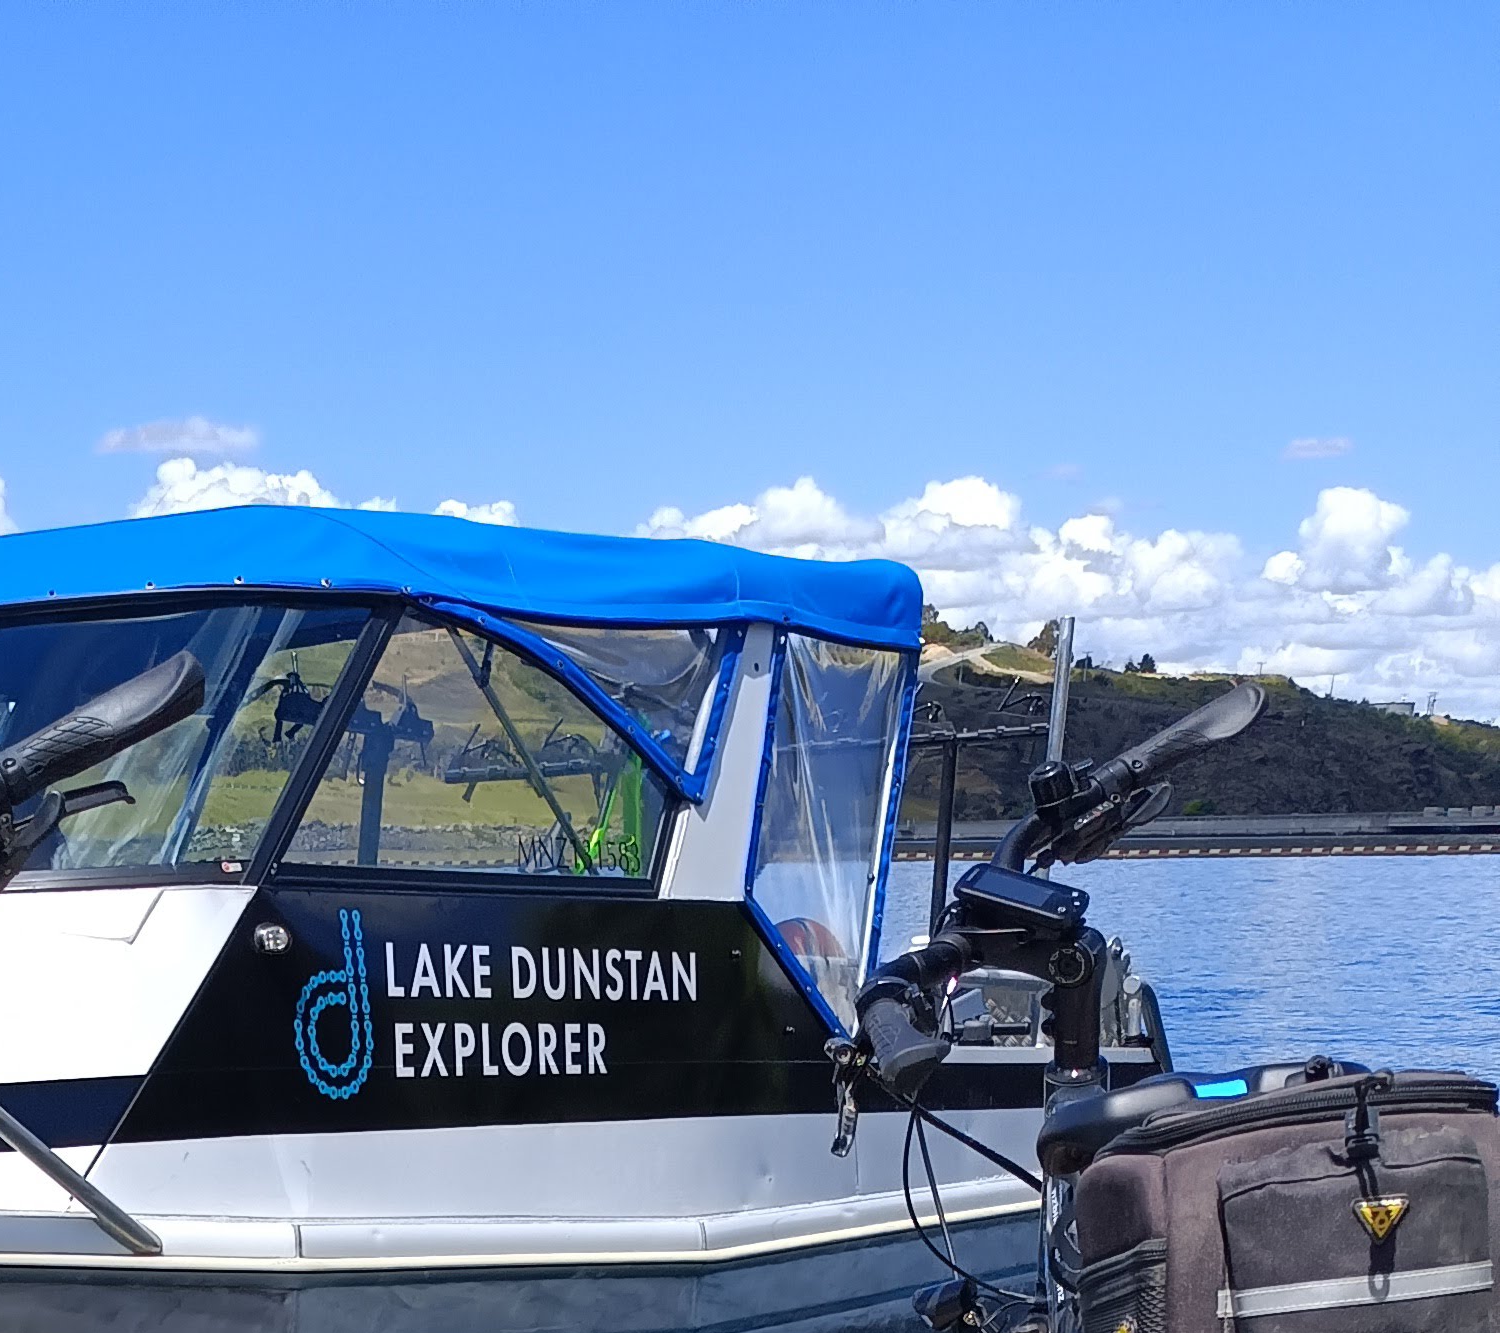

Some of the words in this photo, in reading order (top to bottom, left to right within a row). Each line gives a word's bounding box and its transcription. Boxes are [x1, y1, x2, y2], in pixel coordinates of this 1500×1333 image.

[385, 941, 493, 999] LAKE
[511, 945, 698, 1001] DUNSTAN
[394, 1022, 609, 1079] EXPLORER
